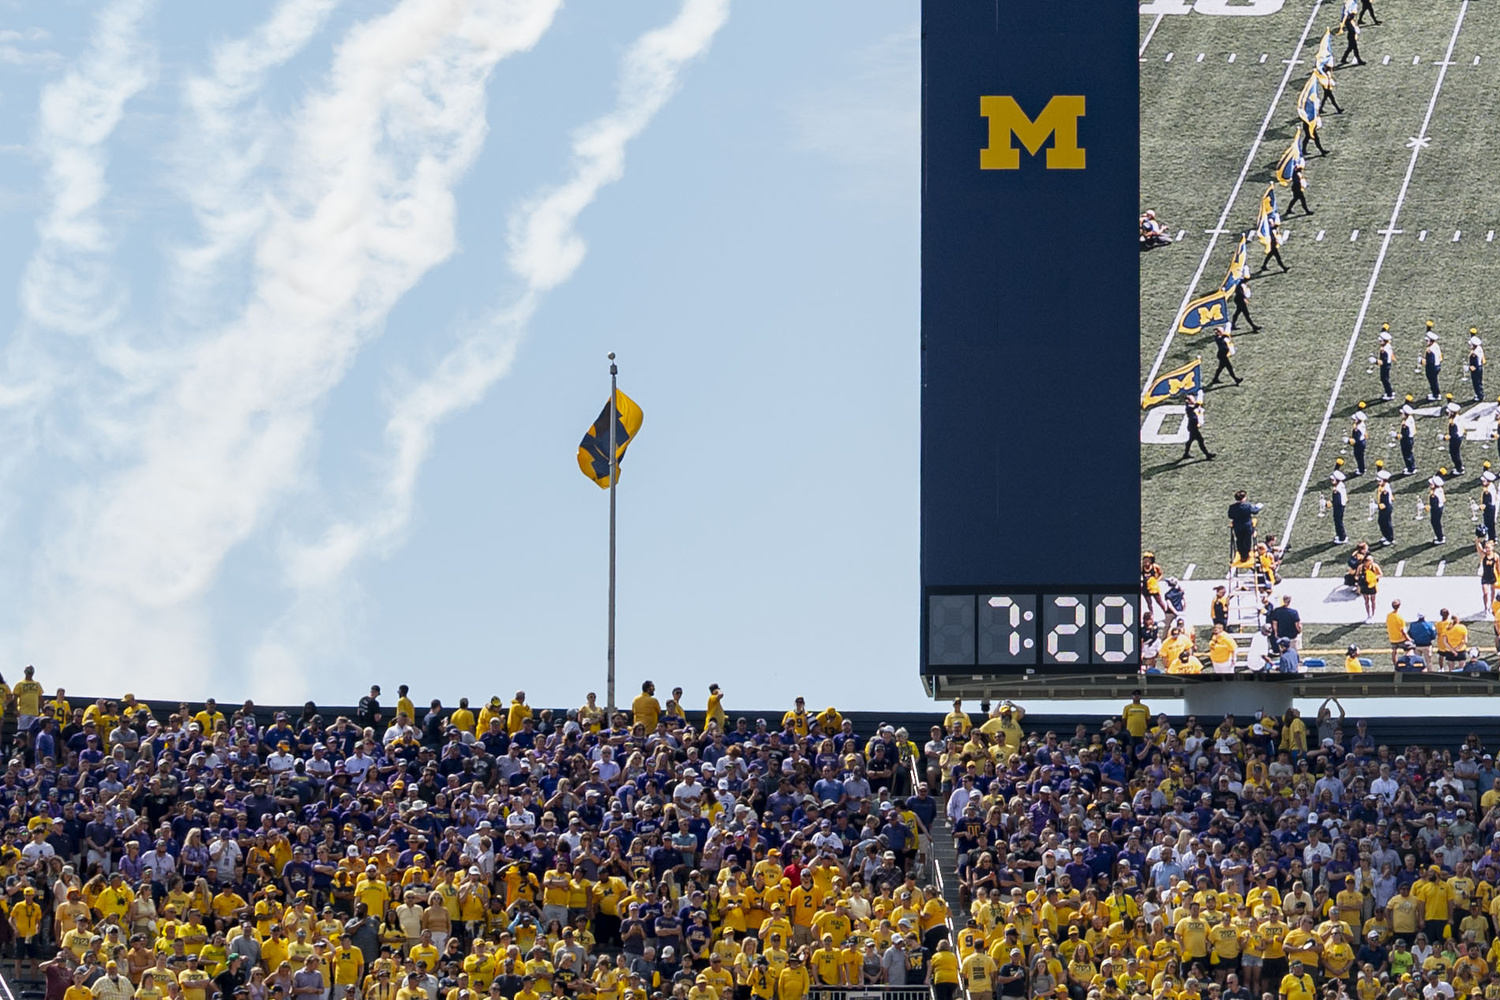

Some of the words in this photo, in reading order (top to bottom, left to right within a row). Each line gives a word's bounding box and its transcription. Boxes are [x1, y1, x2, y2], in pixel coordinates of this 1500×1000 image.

[980, 95, 1086, 170] M
[1198, 303, 1224, 325] M
[1168, 371, 1196, 395] M
[988, 596, 1134, 662] 7:28
[57, 710, 64, 723] 9
[209, 718, 214, 729] 1
[796, 718, 802, 727] 9
[340, 739, 345, 750] 7
[518, 882, 526, 893] 2
[804, 896, 811, 907] 2
[965, 936, 972, 947] 9
[759, 976, 767, 989] 4
[1300, 981, 1305, 992] 1
